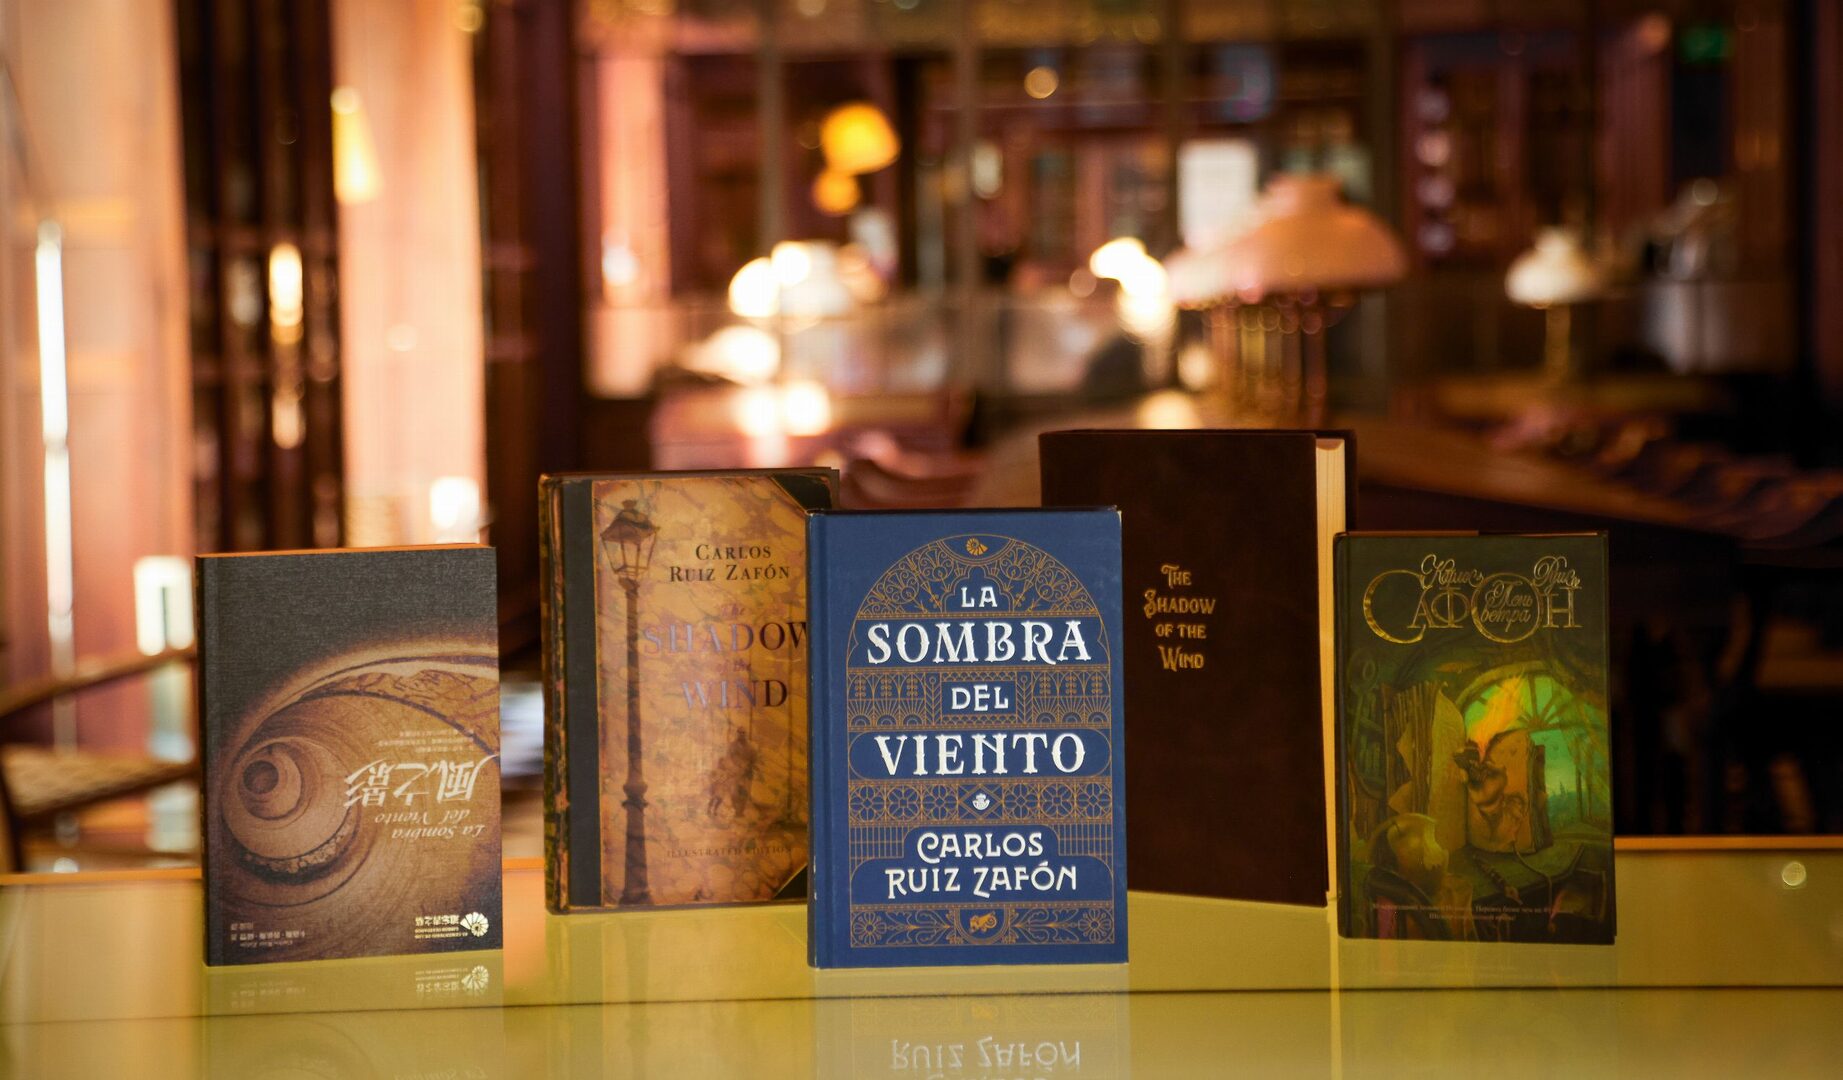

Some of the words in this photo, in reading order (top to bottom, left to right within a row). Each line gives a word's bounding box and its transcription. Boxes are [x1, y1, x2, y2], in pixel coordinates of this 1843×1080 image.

[695, 544, 772, 560] CARLOS
[670, 566, 716, 582] RUIZ
[726, 564, 790, 581] ZAFÓN
[961, 586, 998, 608] LA
[1363, 569, 1583, 644] САФОН
[867, 620, 1092, 665] SOMBRA
[1155, 624, 1174, 638] OF
[1177, 624, 1207, 639] THE
[682, 679, 788, 709] WIND
[951, 684, 1009, 712] DEL
[874, 732, 1086, 776] VIENTO
[343, 753, 499, 807] 風之影
[374, 810, 429, 826] Viento
[438, 808, 470, 825] del
[391, 823, 458, 841] Sombra
[461, 823, 486, 838] La
[917, 832, 1044, 864] CARLOS
[885, 867, 961, 899] RUIZ
[973, 861, 1077, 899] ZAFÓN
